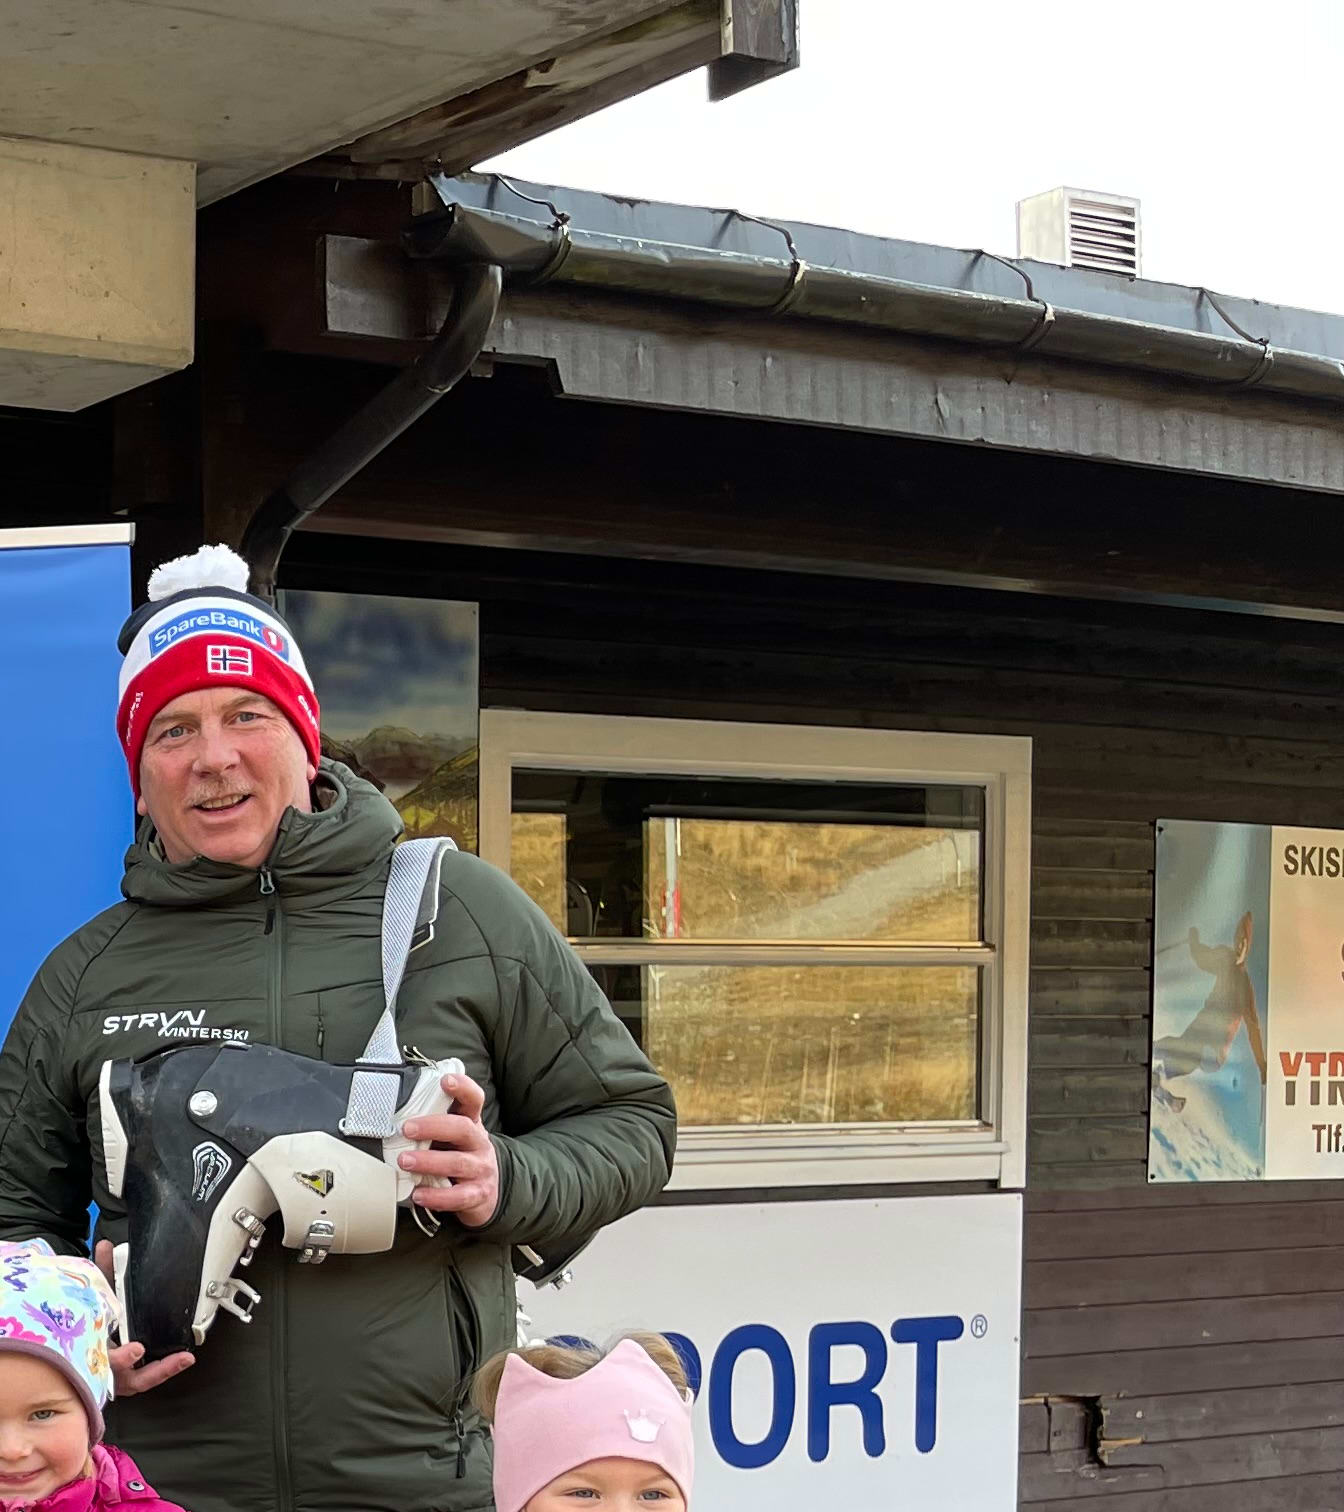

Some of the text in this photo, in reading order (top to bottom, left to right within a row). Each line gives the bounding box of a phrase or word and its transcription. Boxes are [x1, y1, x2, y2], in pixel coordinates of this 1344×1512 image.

[154, 611, 262, 648] SpareBank
[102, 1008, 207, 1037] STRYN
[160, 1026, 250, 1041] VINTERSKI
